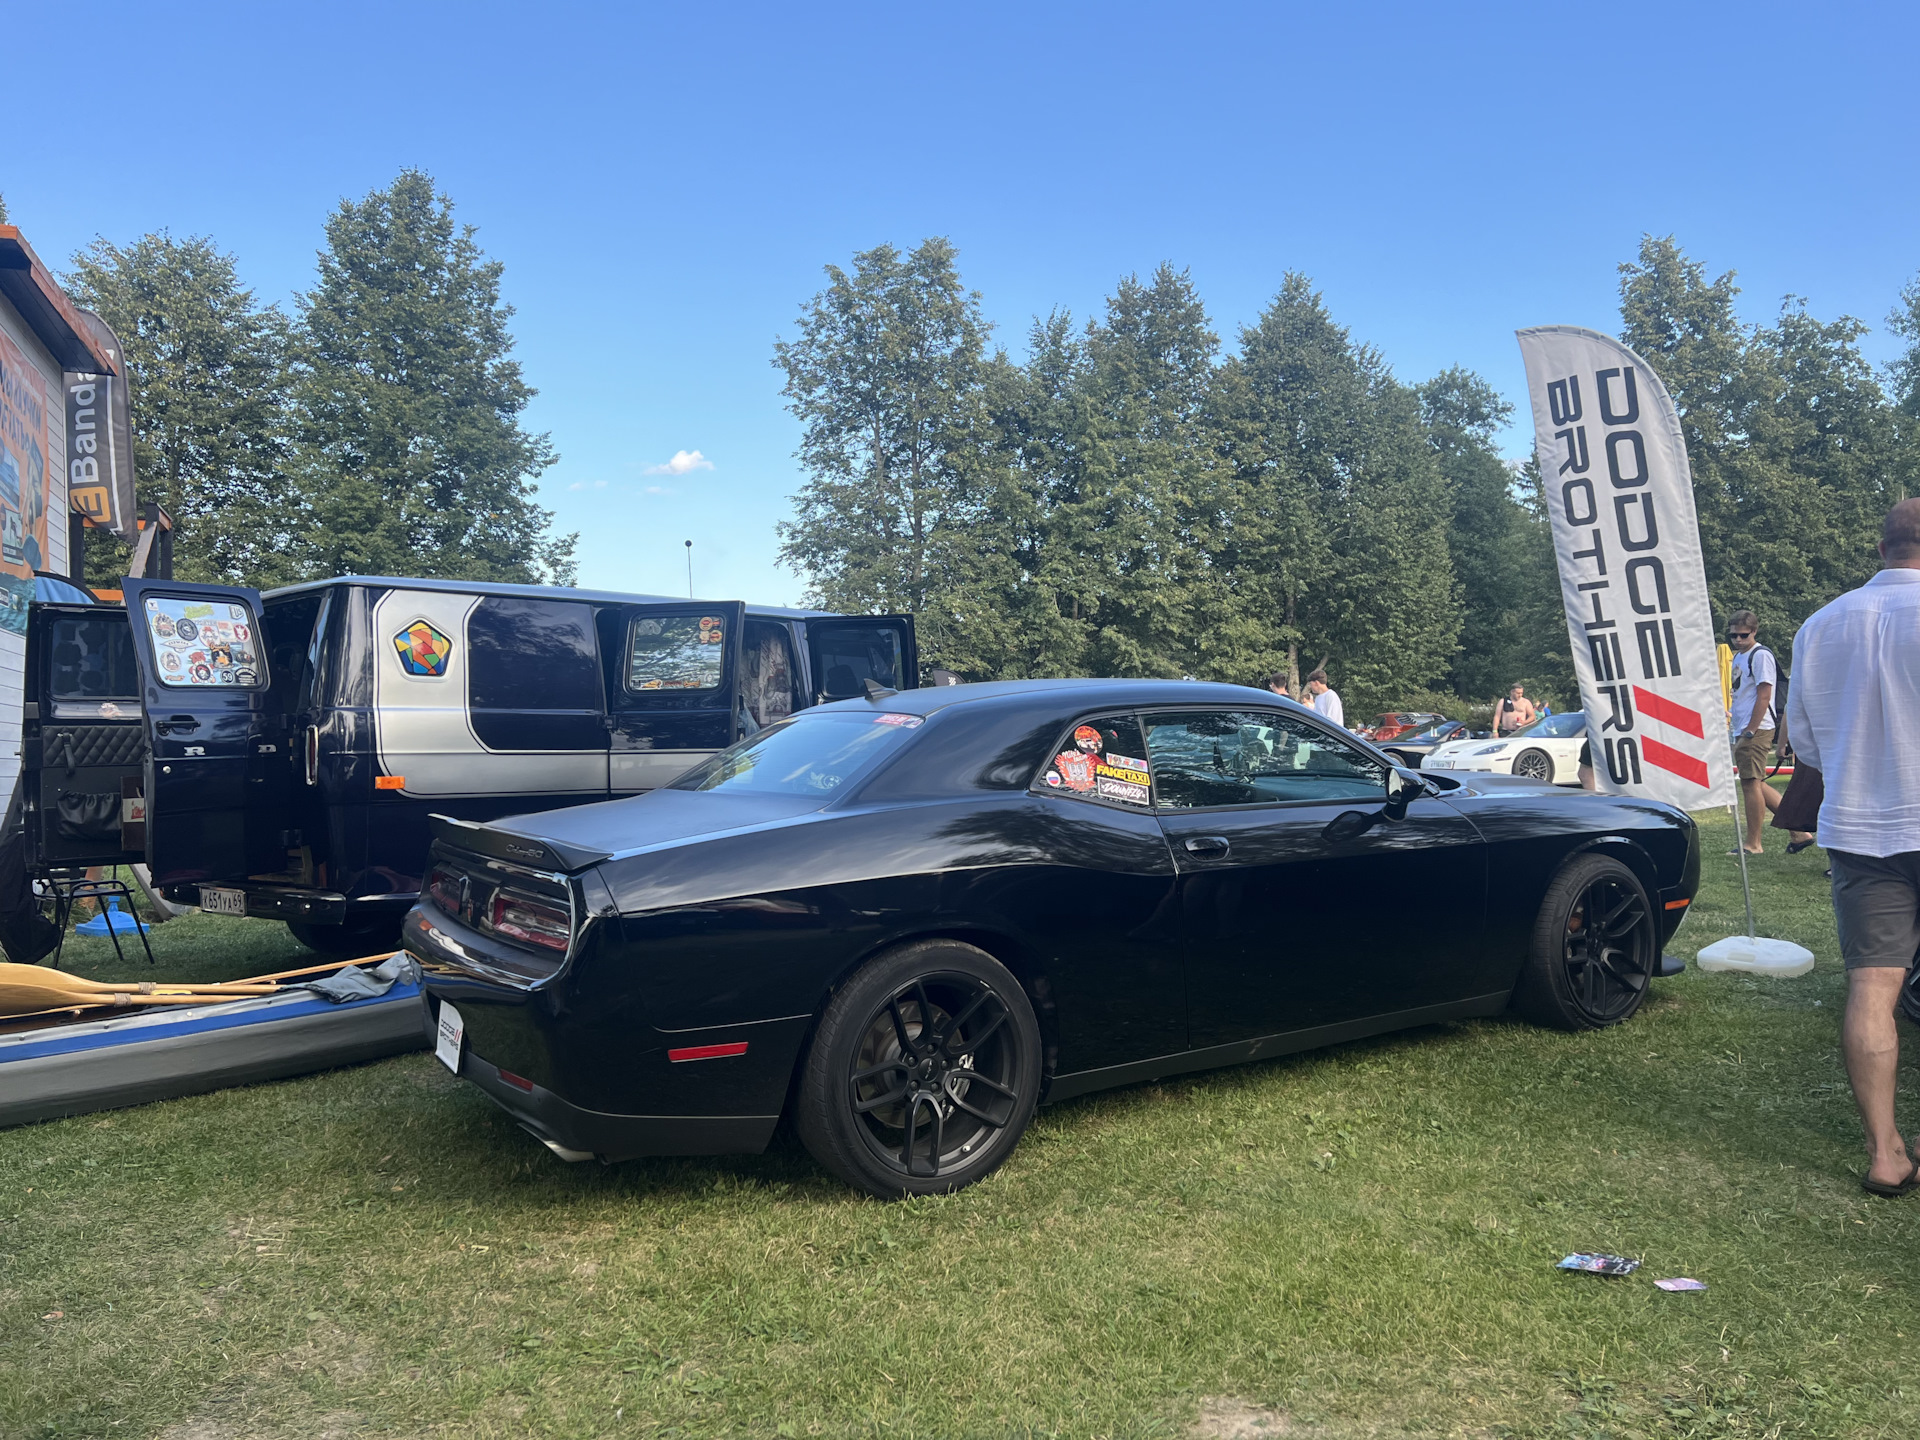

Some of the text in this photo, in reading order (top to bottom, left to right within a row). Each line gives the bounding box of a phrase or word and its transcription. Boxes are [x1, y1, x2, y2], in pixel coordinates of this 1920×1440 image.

[1547, 375, 1642, 785] BROTHERS
[1596, 366, 1682, 679] DODGE
[1096, 764, 1148, 783] FAKE TAXI
